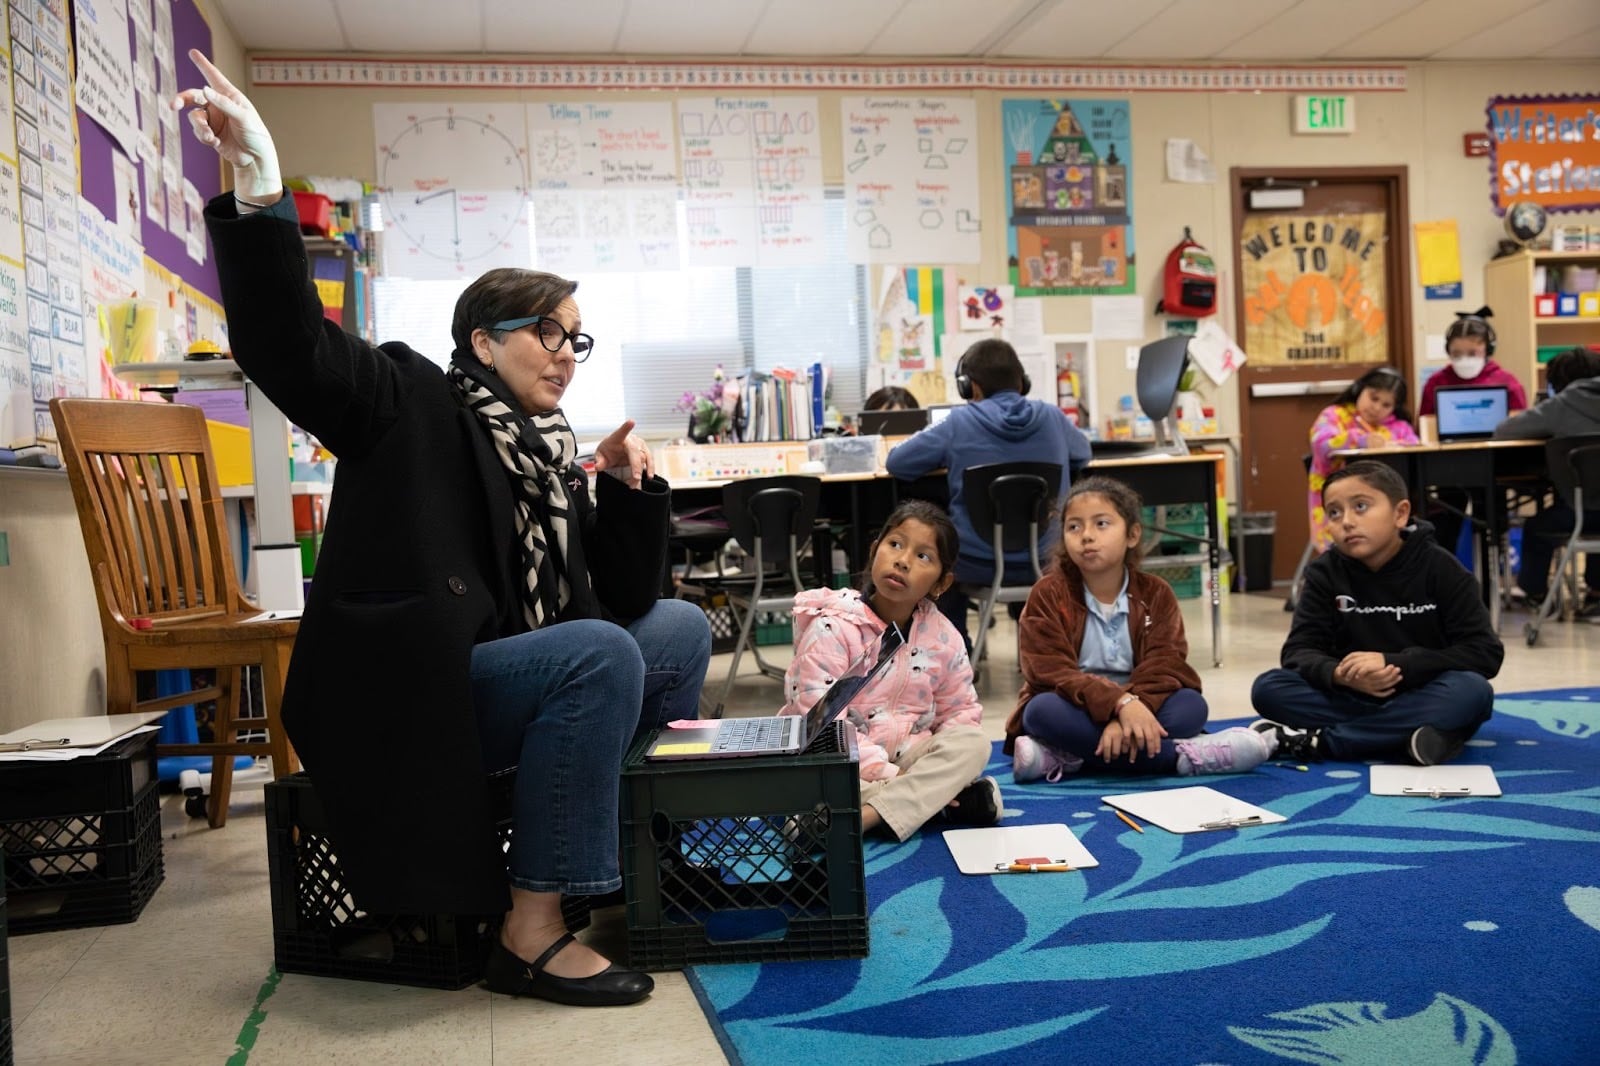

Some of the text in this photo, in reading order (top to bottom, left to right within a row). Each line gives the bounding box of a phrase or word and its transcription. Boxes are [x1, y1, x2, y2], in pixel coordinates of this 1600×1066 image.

[50, 82, 62, 99] Math
[715, 98, 769, 110] Fractions
[864, 98, 946, 109] Geometric Shapes
[1308, 96, 1345, 128] EXIT
[547, 103, 613, 124] Telling Time
[598, 128, 615, 139] The
[1490, 106, 1600, 144] Writer's
[602, 160, 616, 171] The
[1245, 220, 1376, 262] WELCOME
[1293, 246, 1328, 273] TO
[64, 284, 75, 301] ELA
[64, 317, 80, 335] DEAR
[1335, 595, 1437, 621] Champion
